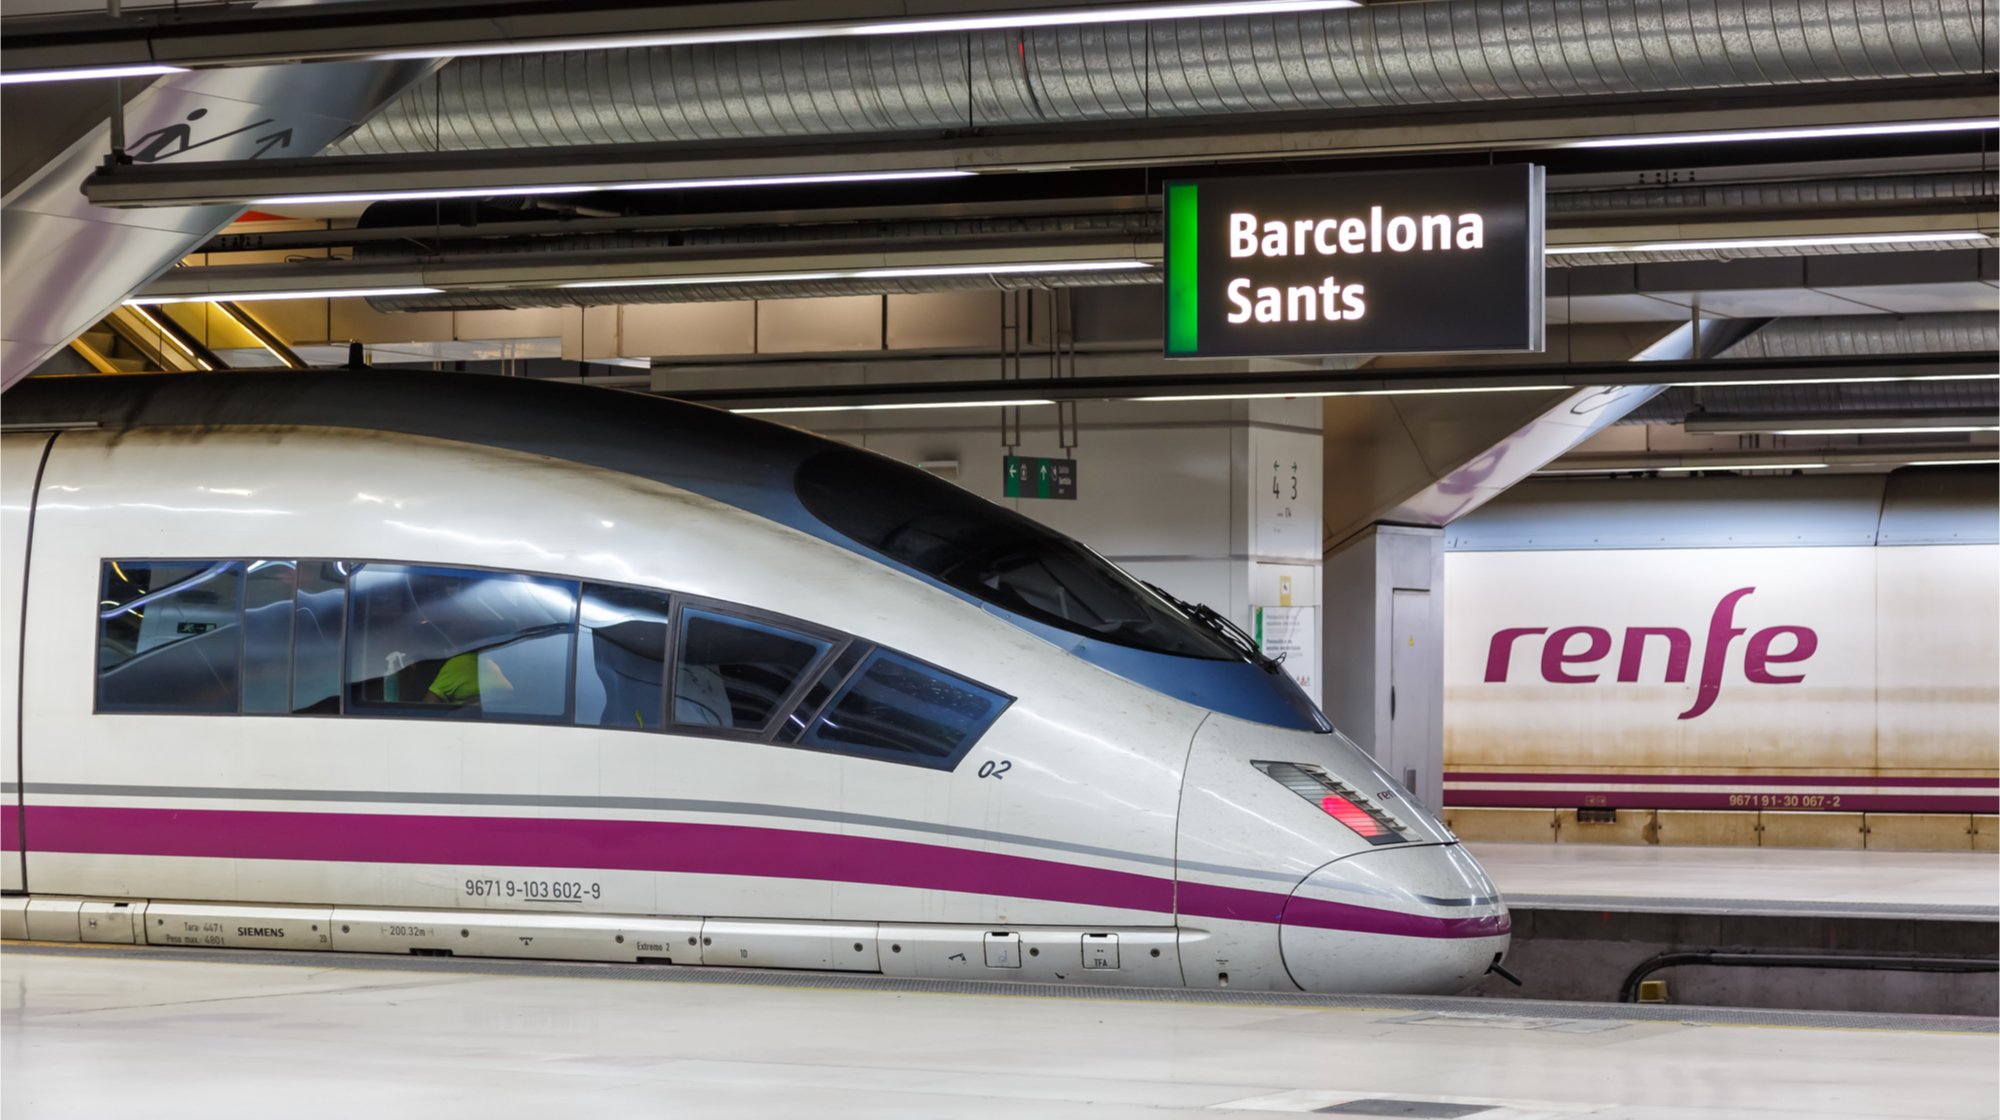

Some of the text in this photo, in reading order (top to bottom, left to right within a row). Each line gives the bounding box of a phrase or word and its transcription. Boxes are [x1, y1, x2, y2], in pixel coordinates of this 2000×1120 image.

[1229, 205, 1484, 258] Barcelona
[1227, 276, 1366, 323] Sants
[1272, 475, 1297, 500] 4 3
[1484, 586, 1818, 720] renfe
[977, 760, 1012, 780] 02
[1728, 795, 1759, 806] 9671
[465, 879, 501, 896] 9671
[237, 926, 284, 938] SIEMENS
[390, 925, 426, 937] 200.32m
[205, 935, 220, 945] 480
[636, 941, 671, 951] Extremo 2
[1093, 958, 1108, 967] TFA
